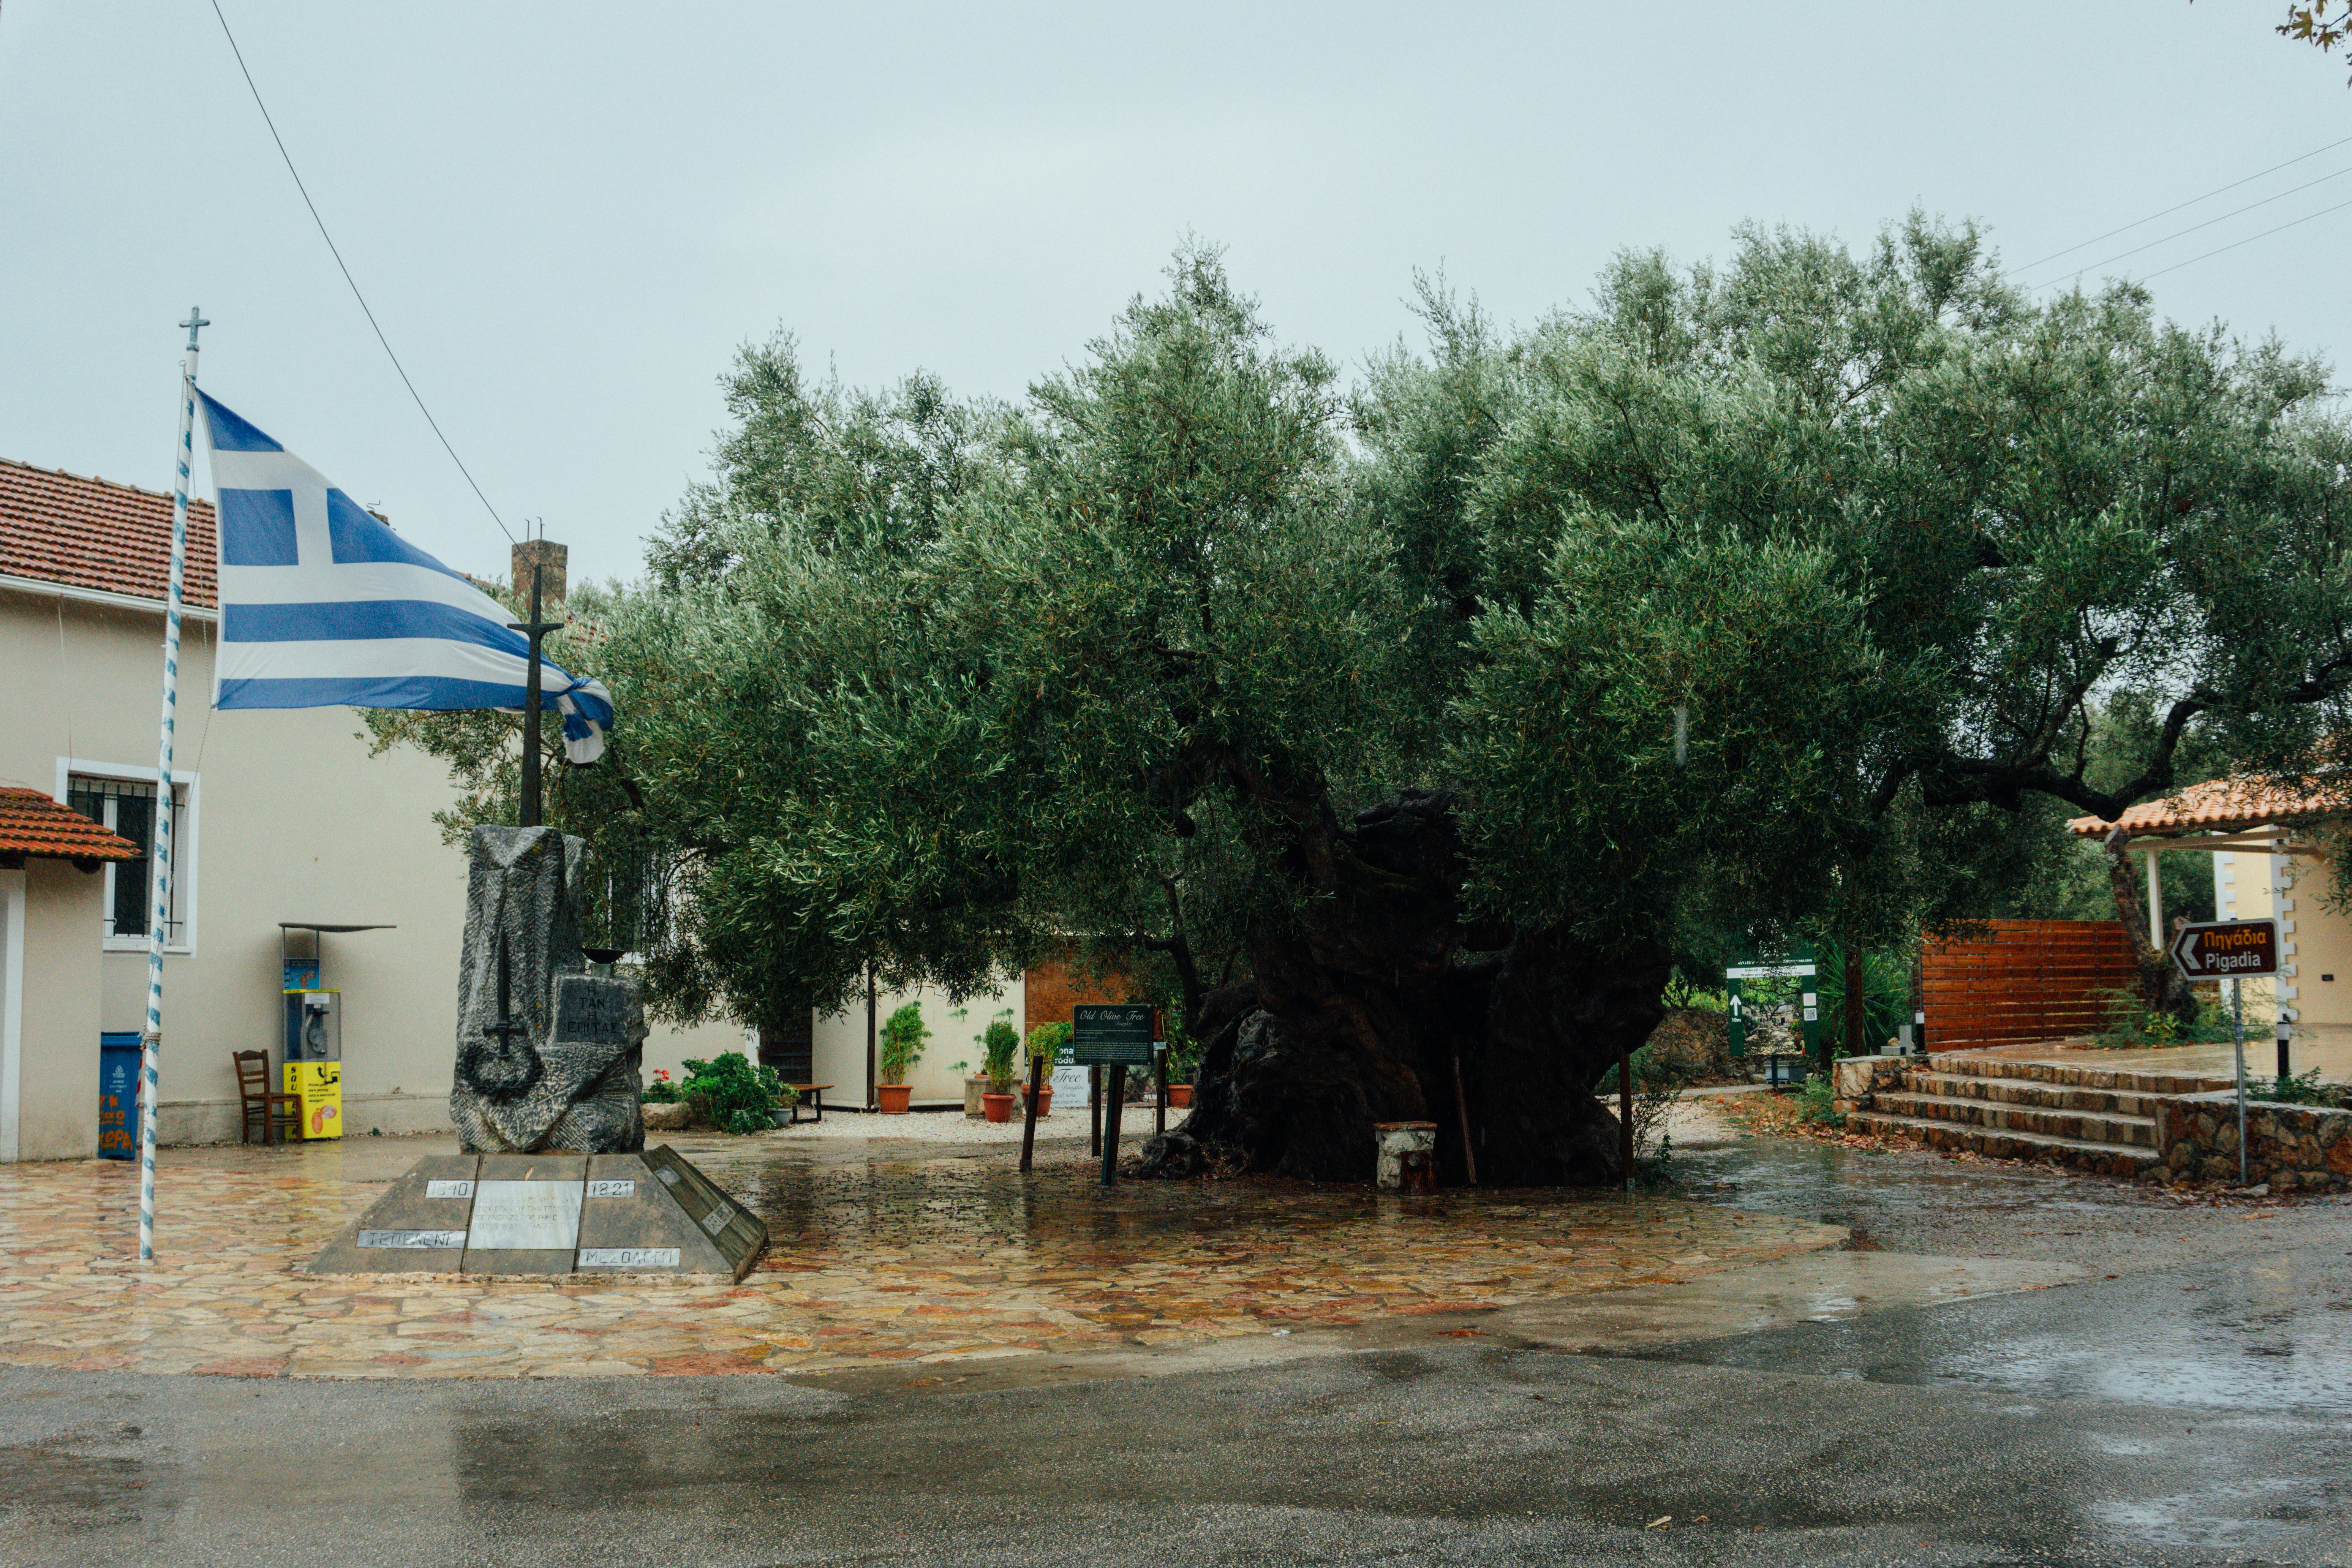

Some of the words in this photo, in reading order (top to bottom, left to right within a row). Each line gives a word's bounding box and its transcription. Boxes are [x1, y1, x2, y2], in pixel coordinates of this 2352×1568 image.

[2204, 929, 2267, 950] Πηγάδια
[2205, 951, 2261, 972] Pigadia
[579, 997, 605, 1008] ΤΑΝ
[1080, 1010, 1096, 1020] Old
[1100, 1010, 1121, 1020] Olive
[1126, 1011, 1145, 1020] Tree
[1054, 1069, 1083, 1083] Tree
[433, 1182, 468, 1195] 1940
[592, 1182, 629, 1195] 1821
